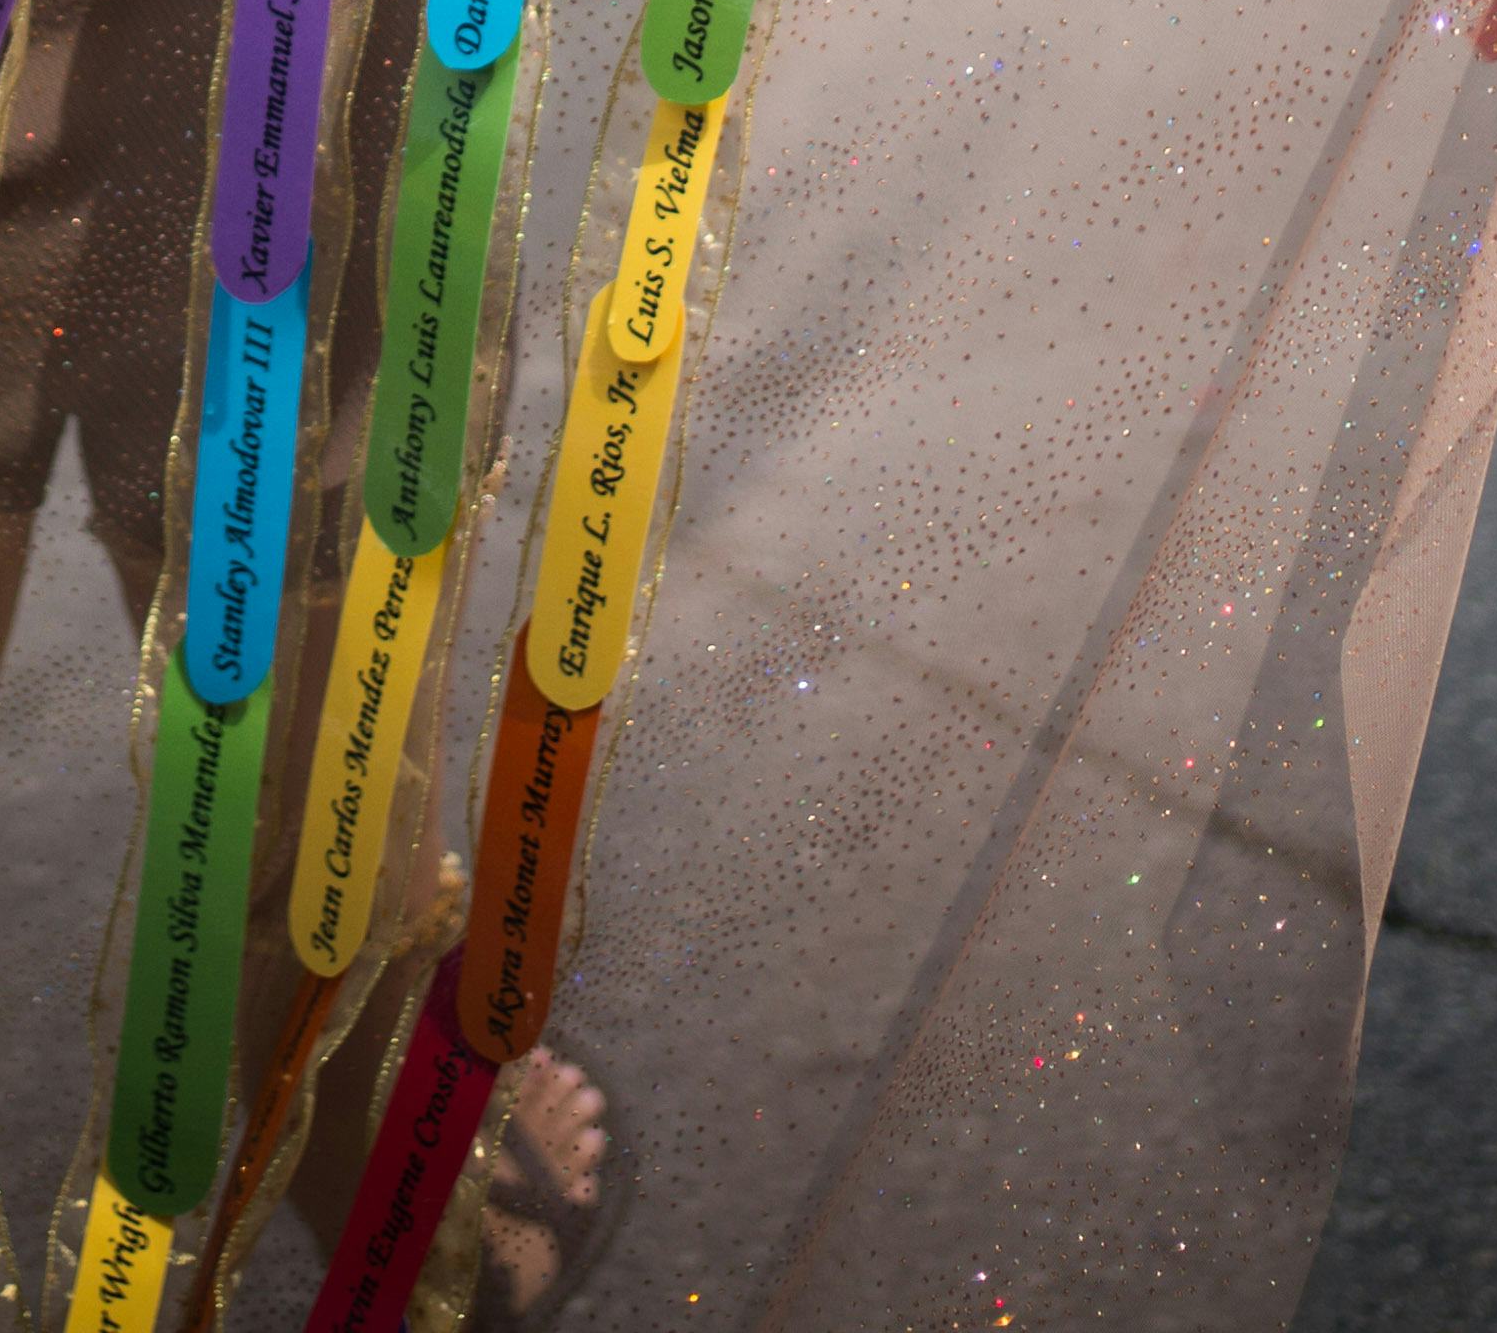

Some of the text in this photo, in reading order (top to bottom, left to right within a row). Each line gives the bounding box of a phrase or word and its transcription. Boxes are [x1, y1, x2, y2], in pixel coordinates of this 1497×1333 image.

[254, 0, 298, 177] Emmanuel
[240, 182, 273, 293] Xavier
[627, 110, 704, 346] Luis S. Vielma
[408, 312, 438, 387] Luis
[213, 318, 272, 681] Stanley Almodovar III
[391, 393, 436, 541] Anthony
[559, 371, 638, 676] Enrique L. Rios, Jr.
[311, 557, 412, 963] Jean Carlos Mendez Perez
[138, 704, 227, 1193] Gilberto Ramon Silva Menendez
[487, 701, 572, 1054] Akyra Monet Murray
[99, 1202, 149, 1304] Wrigh
[366, 1151, 424, 1268] Eugene
[413, 1039, 472, 1150] Crosby
